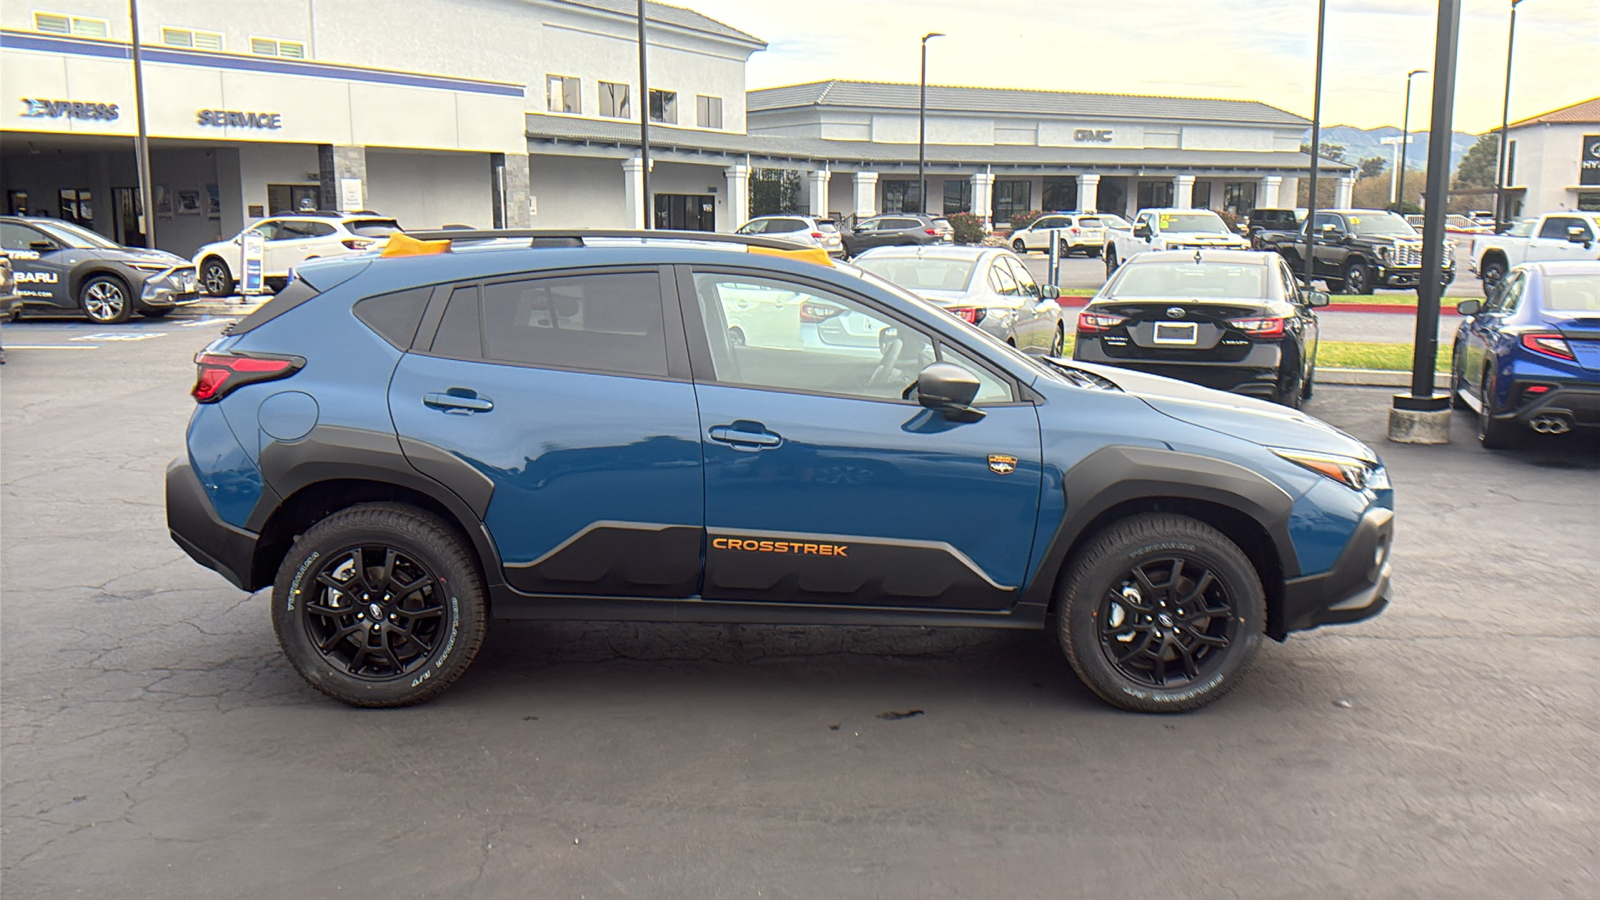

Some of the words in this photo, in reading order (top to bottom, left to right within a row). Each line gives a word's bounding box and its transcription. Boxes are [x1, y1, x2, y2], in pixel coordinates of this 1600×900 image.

[20, 99, 119, 121] EXPRESS
[197, 109, 282, 129] SERVICE
[1074, 129, 1113, 142] GMC
[712, 538, 849, 557] CROSSTREK
